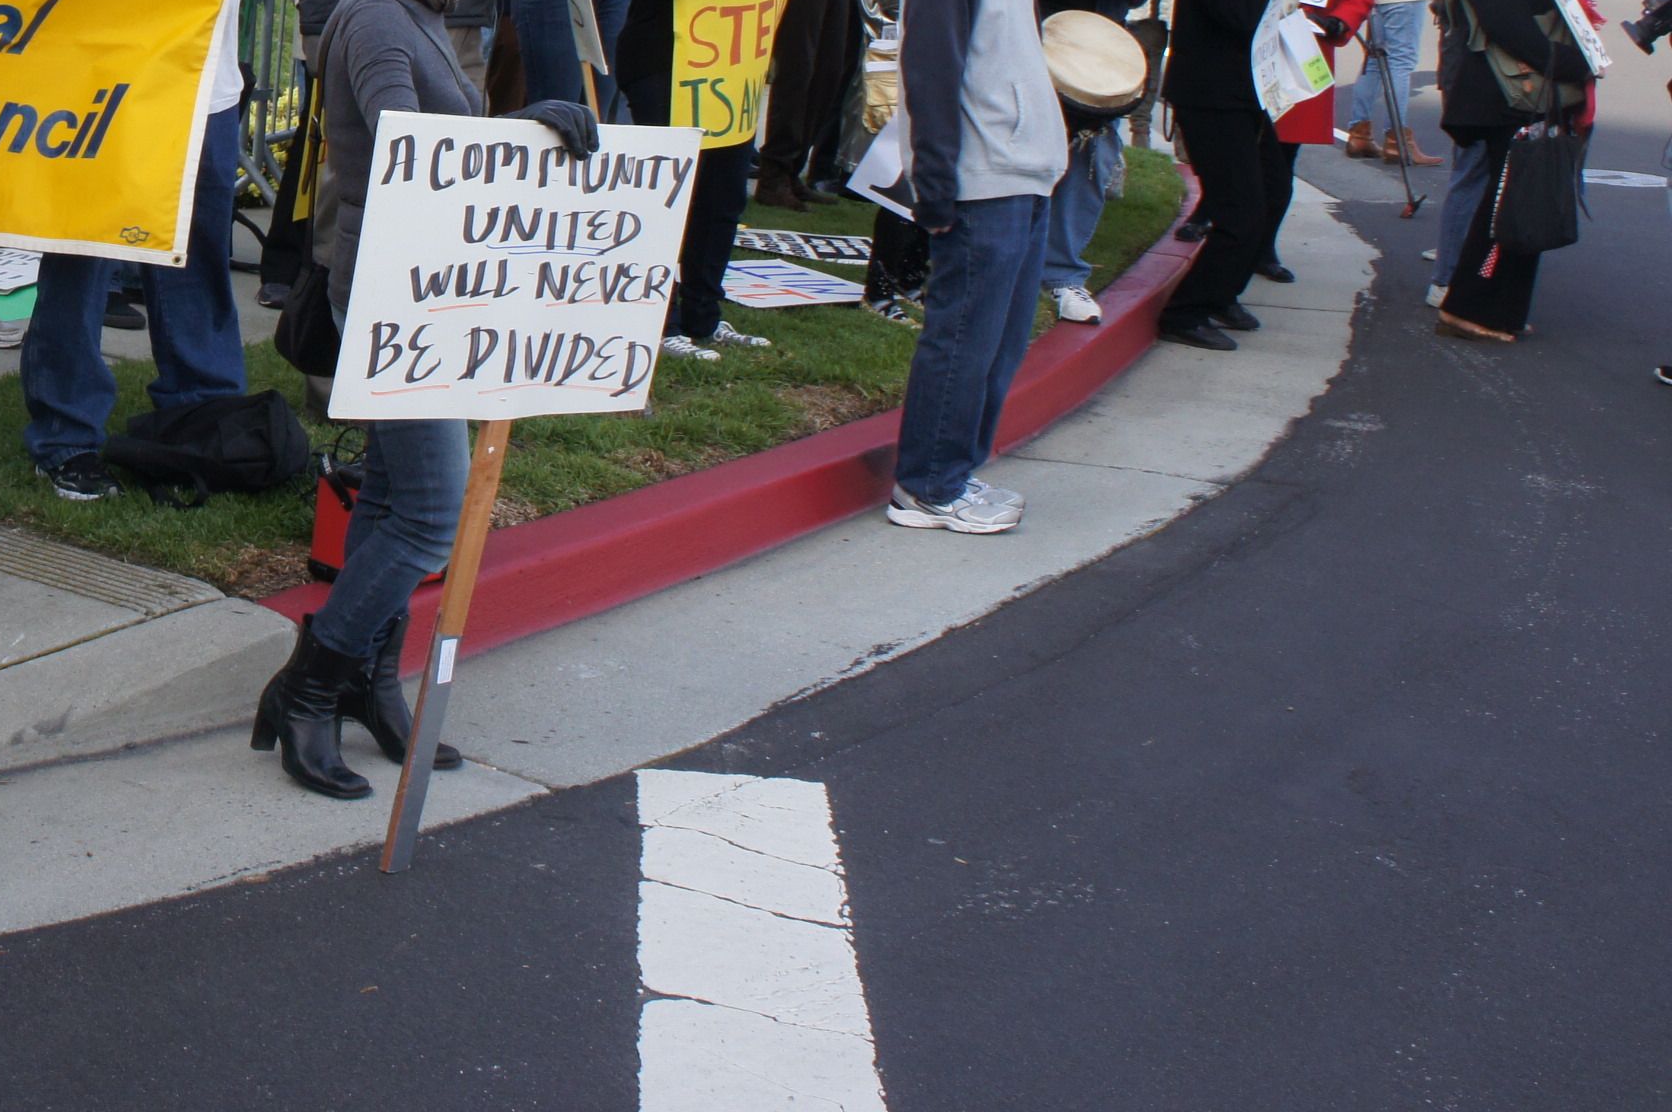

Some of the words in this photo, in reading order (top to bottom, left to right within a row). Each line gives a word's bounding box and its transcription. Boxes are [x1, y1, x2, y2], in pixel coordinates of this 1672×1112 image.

[680, 78, 734, 138] IS
[381, 135, 417, 185] A
[463, 204, 642, 255] UNITED
[410, 258, 520, 304] WILL
[535, 261, 671, 305] NEVER
[364, 321, 442, 384] BE
[457, 326, 653, 398] DIVIDED
